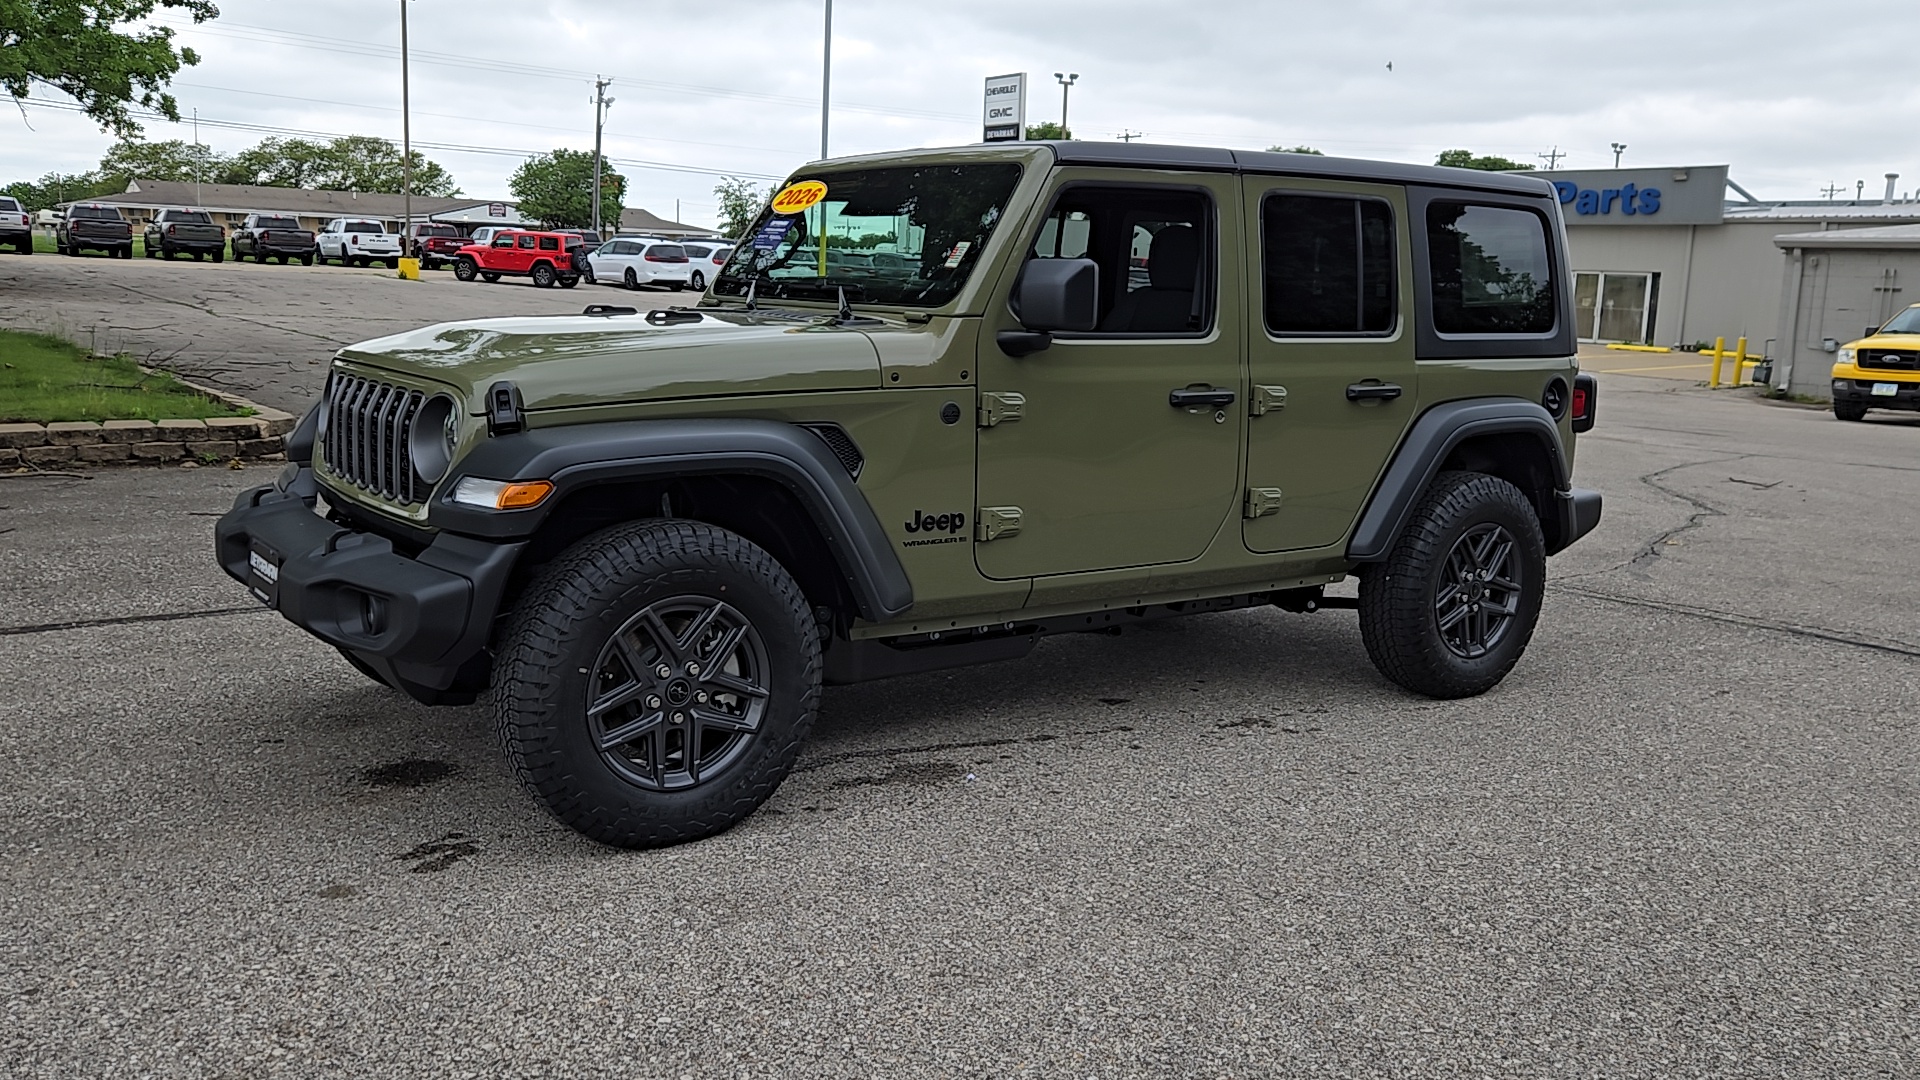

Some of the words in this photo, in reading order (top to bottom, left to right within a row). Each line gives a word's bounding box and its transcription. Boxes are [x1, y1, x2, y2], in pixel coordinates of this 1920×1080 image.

[986, 84, 1017, 96] CHEVROLET
[989, 106, 1013, 119] GMC
[775, 187, 823, 206] 2026
[1553, 181, 1661, 215] Parts
[904, 509, 965, 534] Jeep
[902, 537, 958, 548] WRANGLER
